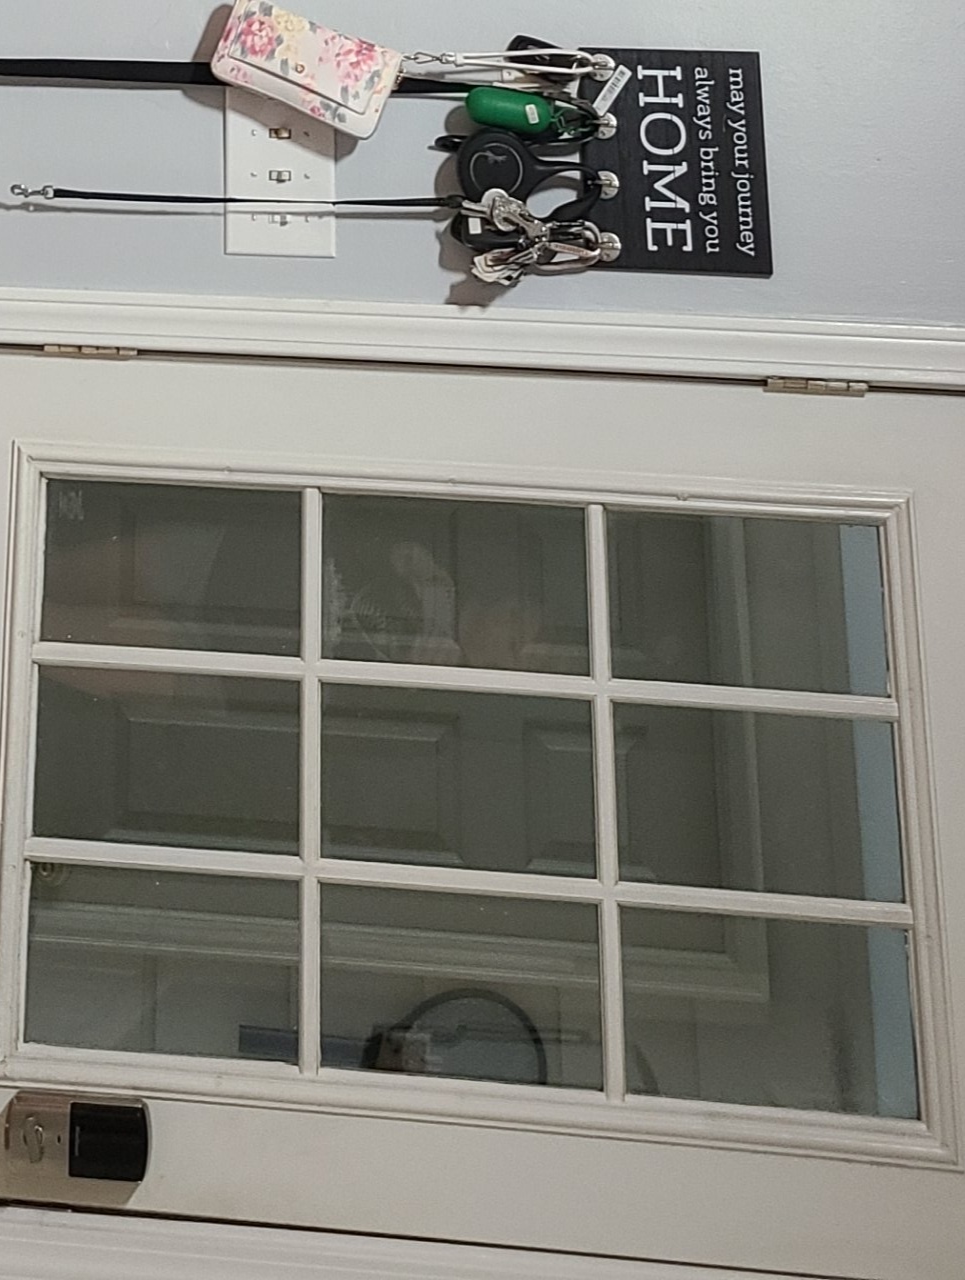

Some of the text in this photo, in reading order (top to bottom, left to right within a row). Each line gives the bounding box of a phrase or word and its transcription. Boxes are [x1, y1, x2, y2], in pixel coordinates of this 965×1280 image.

[636, 64, 693, 252] HOME
[692, 67, 720, 253] always bring you
[726, 68, 755, 256] may your journey
